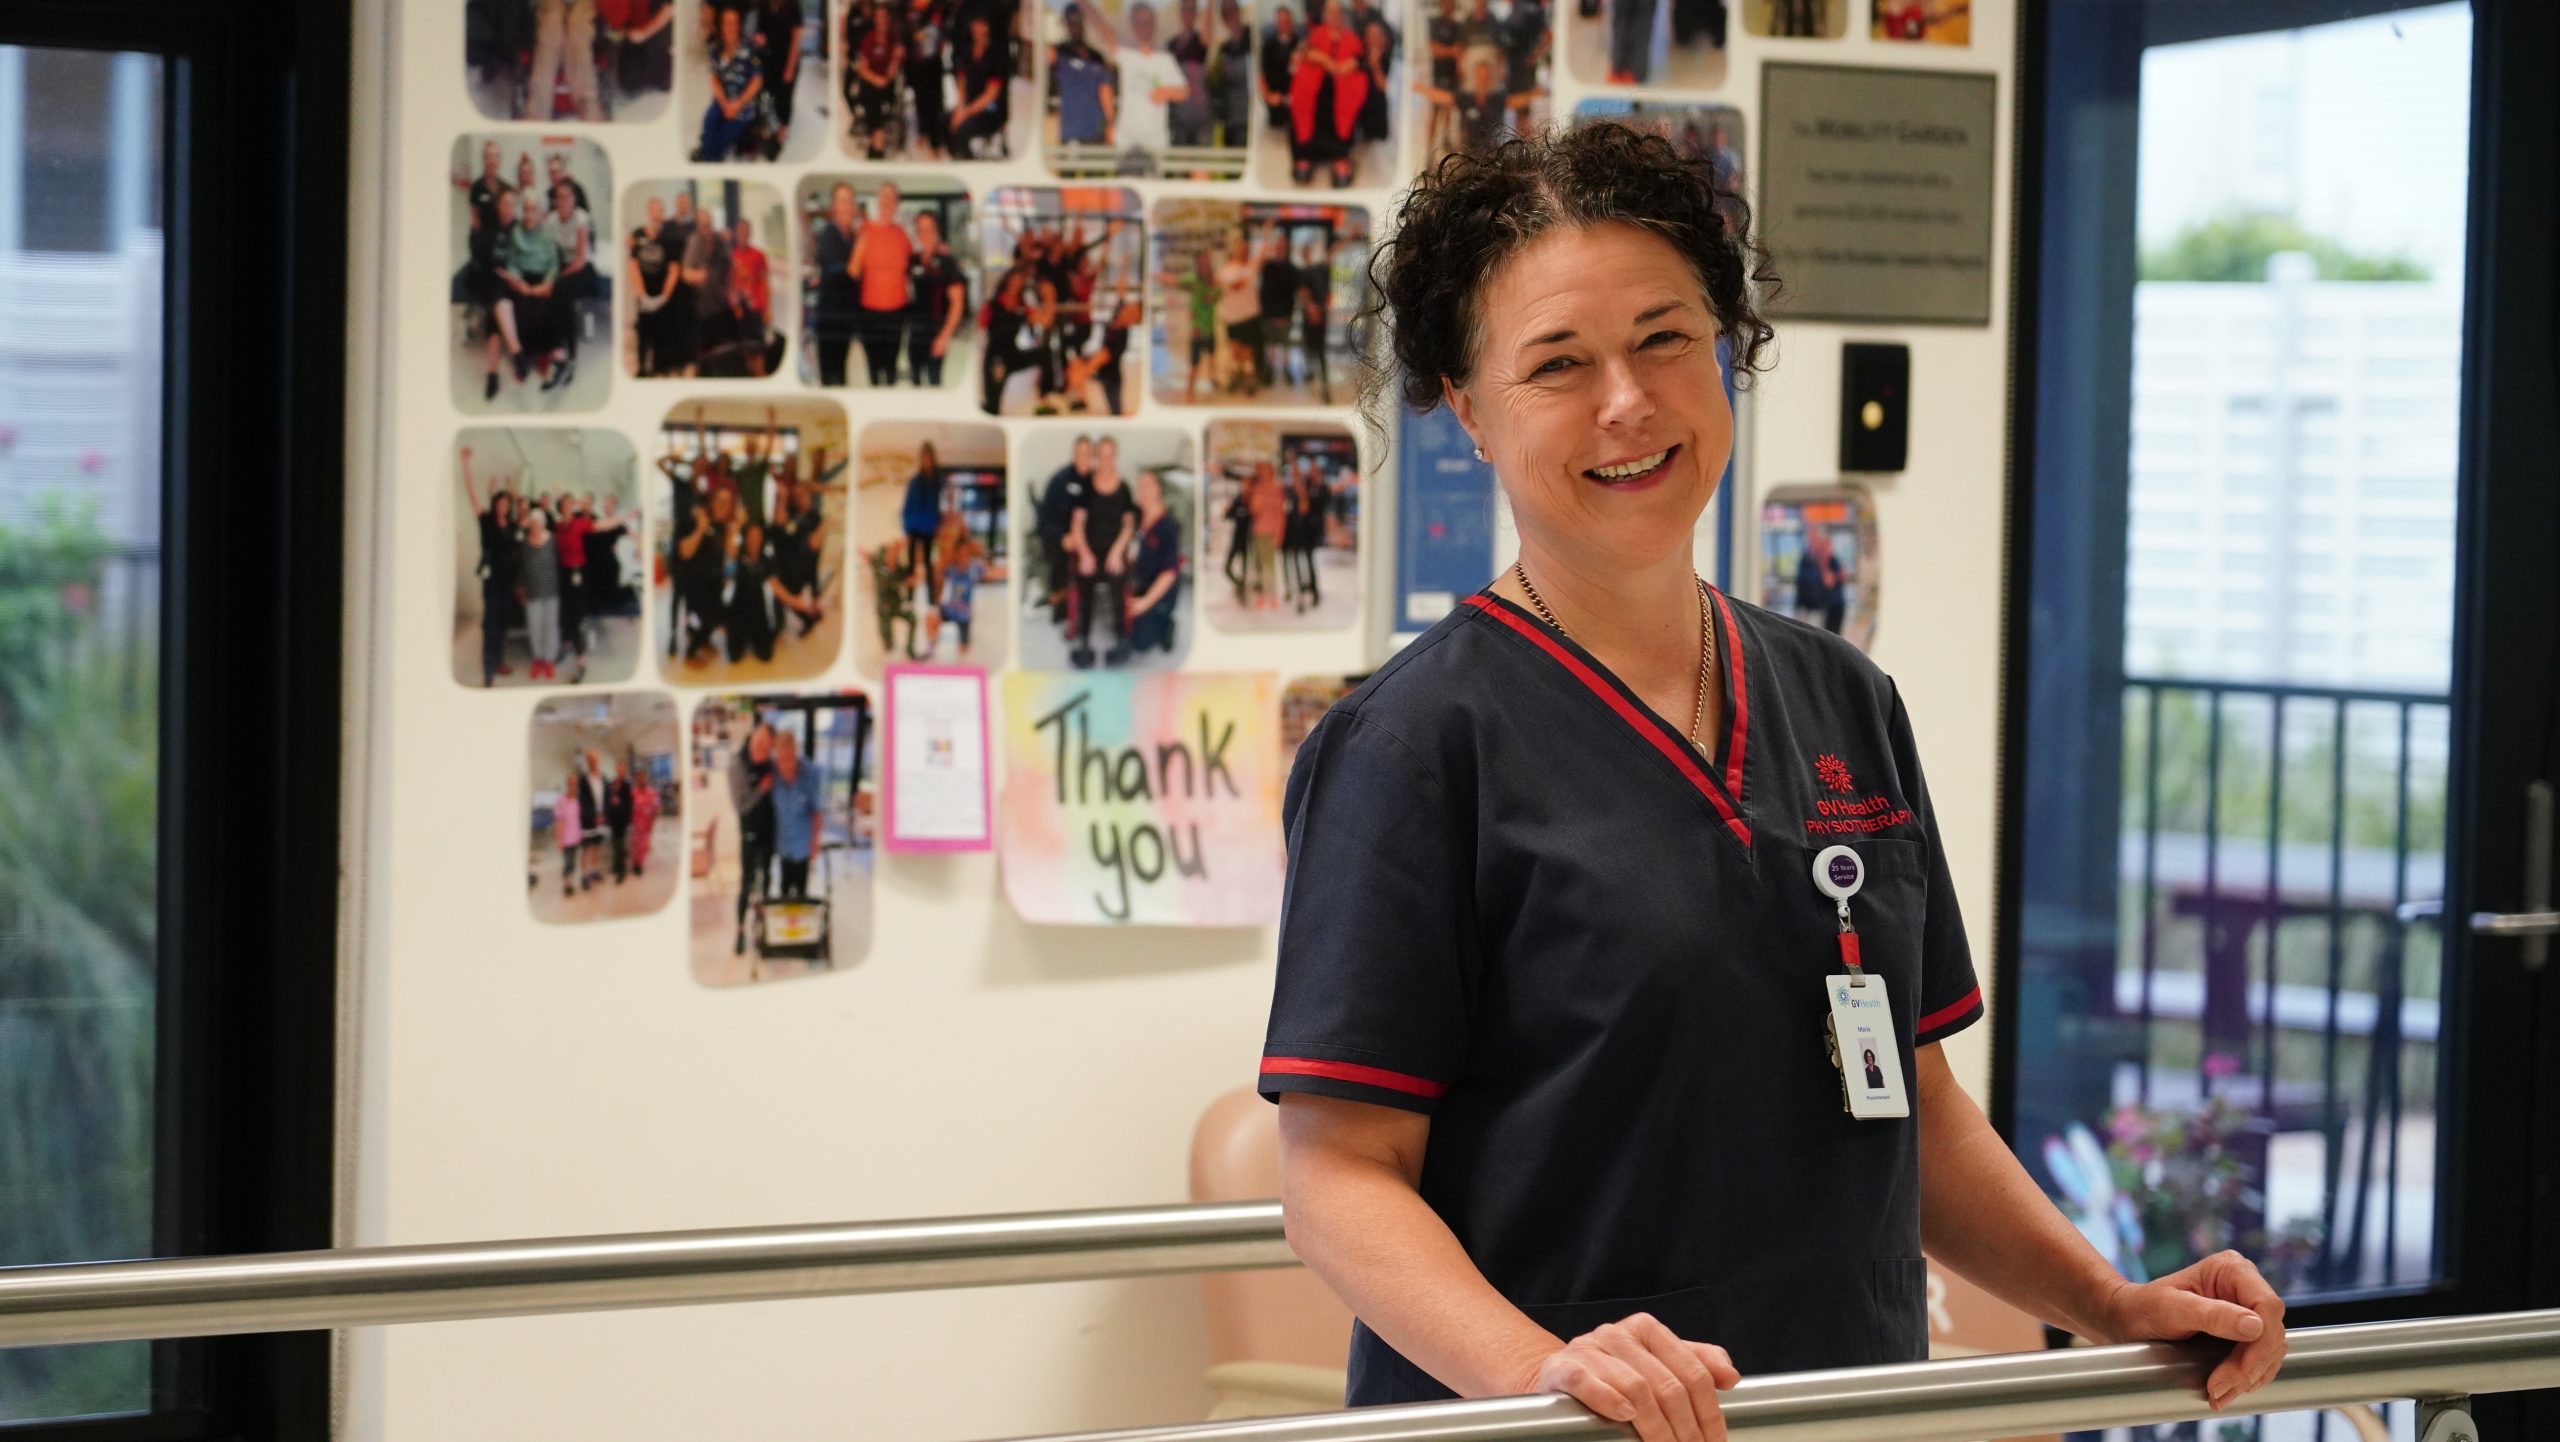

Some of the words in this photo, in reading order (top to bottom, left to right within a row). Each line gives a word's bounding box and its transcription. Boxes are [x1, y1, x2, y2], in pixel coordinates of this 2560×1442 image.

[1034, 690, 1240, 805] Thank
[1805, 810, 1913, 836] PHYSIOTHERAPY
[1089, 821, 1208, 921] you
[1834, 873, 1855, 881] Service
